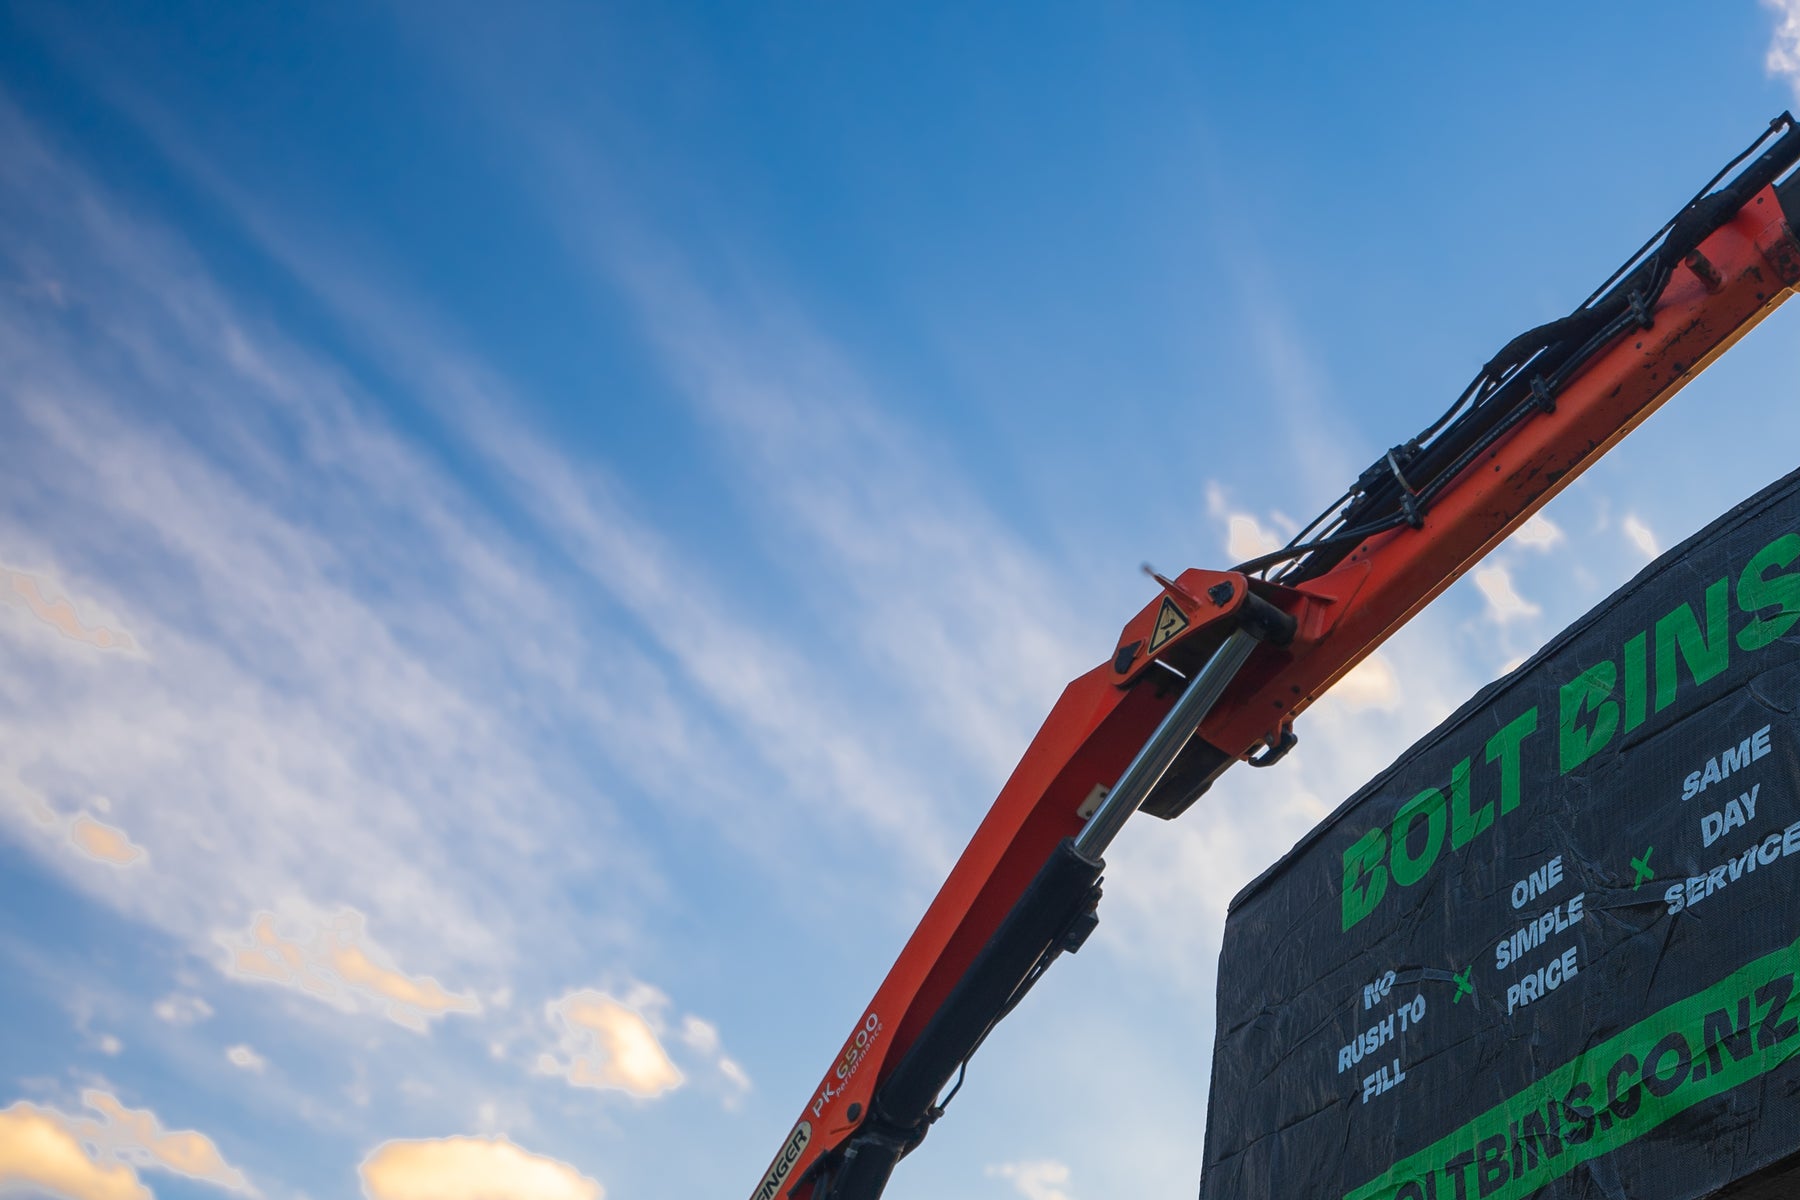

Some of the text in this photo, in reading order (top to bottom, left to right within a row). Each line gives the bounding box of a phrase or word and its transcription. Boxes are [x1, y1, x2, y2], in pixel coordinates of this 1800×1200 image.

[1681, 723, 1771, 801] SAME
[1342, 705, 1538, 932] BOLT
[1701, 784, 1761, 848] DAY
[1511, 855, 1563, 909] ONE
[1495, 892, 1585, 970] SIMPLE
[1363, 970, 1396, 1010] NO
[1506, 946, 1579, 1016] PRICE
[811, 1012, 879, 1118] PK 6500
[1338, 994, 1426, 1074] RUSH TO
[1363, 1058, 1405, 1104] FILL
